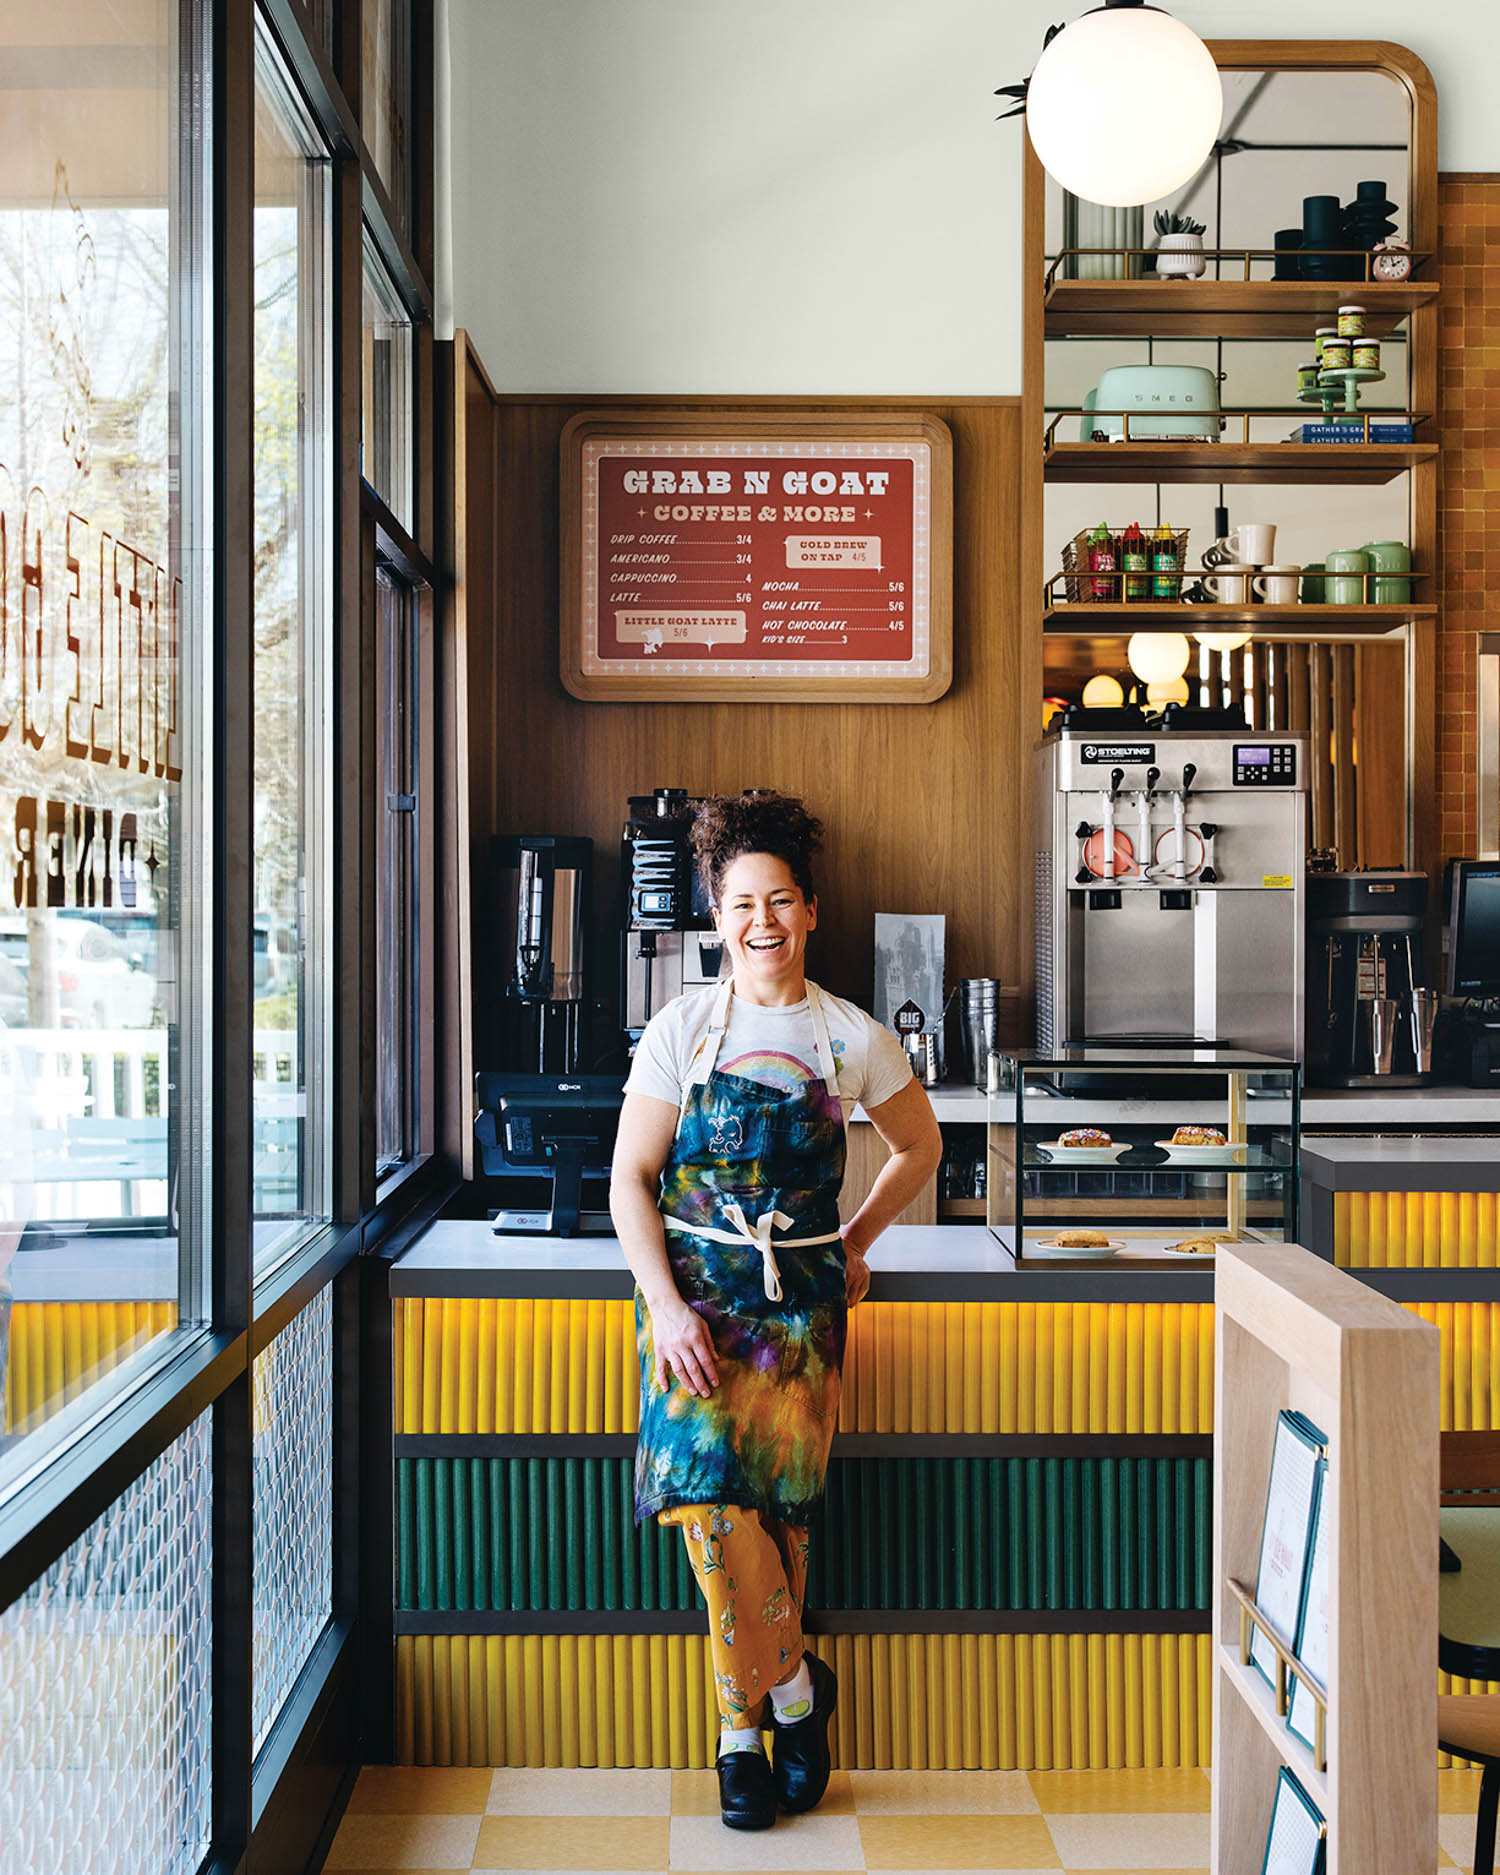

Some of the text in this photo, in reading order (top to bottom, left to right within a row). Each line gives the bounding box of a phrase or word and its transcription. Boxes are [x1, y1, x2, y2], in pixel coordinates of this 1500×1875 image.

[1135, 394, 1193, 402] SMEG
[623, 470, 889, 495] GRAB N GOAT
[653, 505, 856, 522] COFFEE & MORE
[610, 535, 752, 545] DRIP COFFEE 3/4
[800, 541, 831, 549] COLD
[610, 554, 752, 564] AMERICANO 3/4
[801, 553, 866, 561] ON TAP 4/5
[610, 573, 752, 583] CAPPUCCINO 4
[762, 582, 905, 592] MOCHA 5/6
[610, 593, 752, 603] LATTE 5/6
[762, 601, 905, 611] CHAI LATTE 5/6
[624, 617, 665, 625] LITTLE
[667, 617, 699, 625] GOAT
[762, 620, 905, 631] HOT CHOCOLATE 4/5
[673, 628, 688, 637] 5/6
[841, 635, 848, 644] 3
[900, 1012, 920, 1024] BIG
